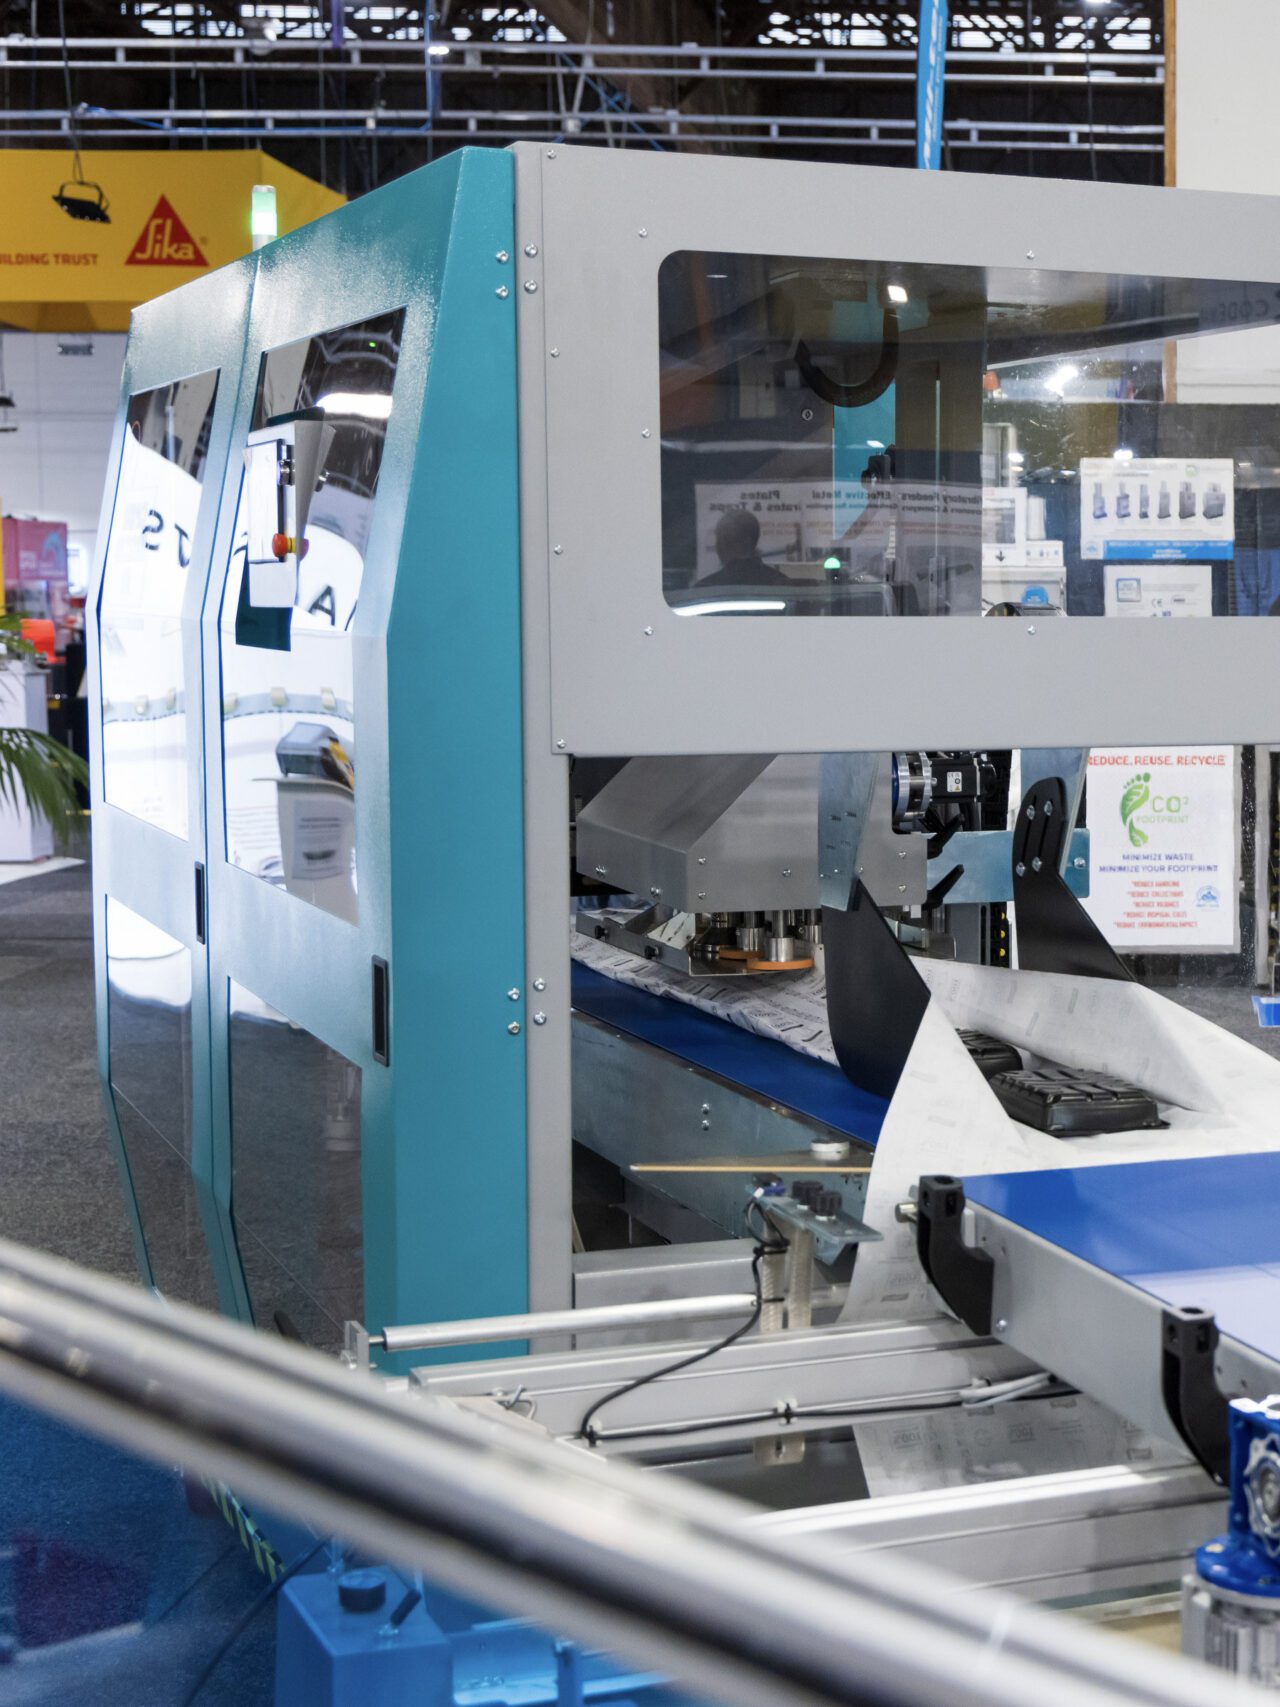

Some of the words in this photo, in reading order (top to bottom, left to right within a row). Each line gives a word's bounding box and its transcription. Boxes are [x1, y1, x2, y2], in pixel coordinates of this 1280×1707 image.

[135, 218, 195, 260] Sika
[53, 253, 98, 266] TRUST
[1176, 754, 1226, 766] RECYCLE
[1122, 853, 1162, 861] MINIMIZE
[1165, 853, 1194, 861] WASTE
